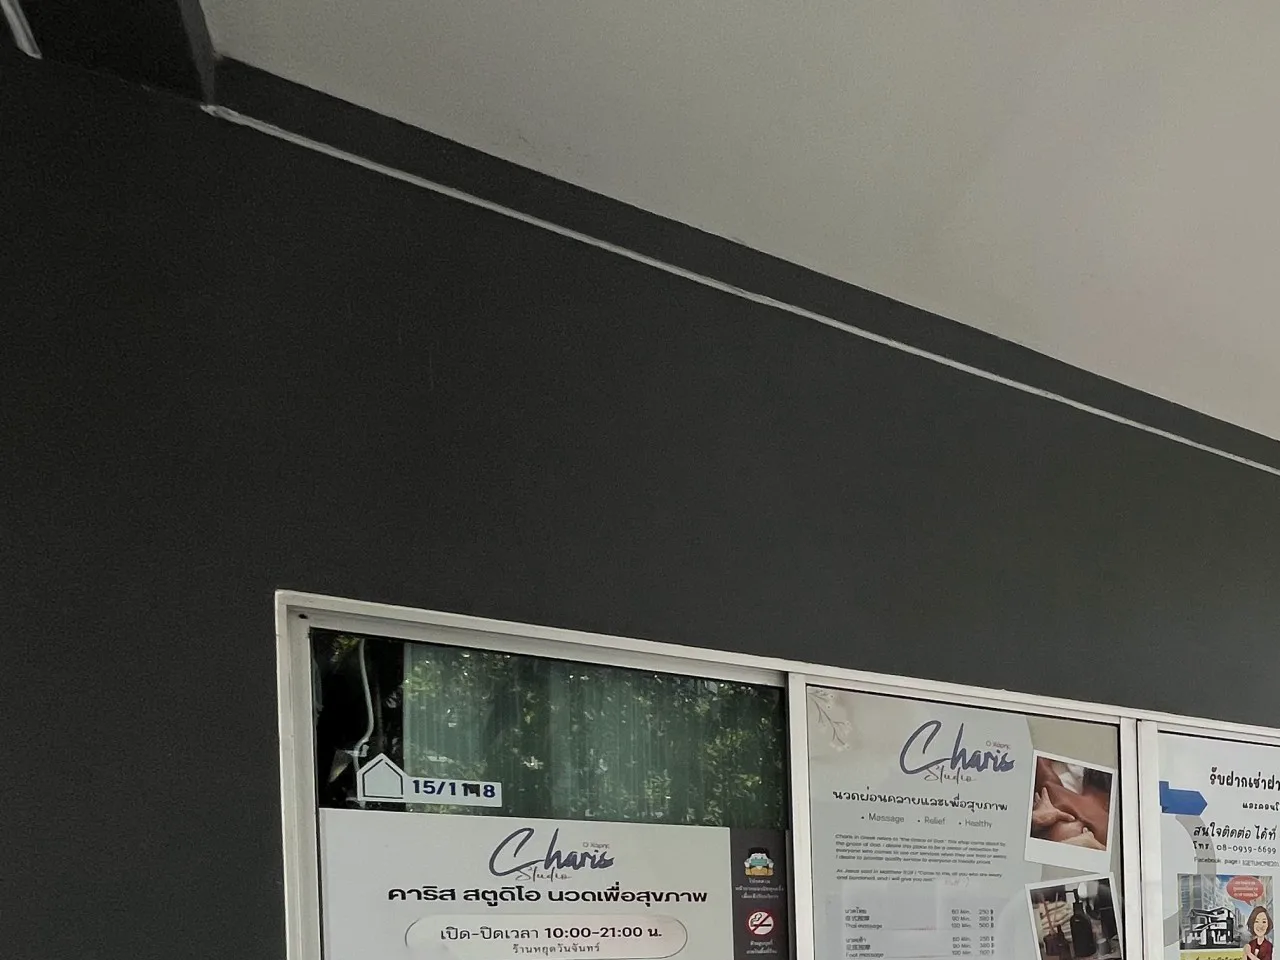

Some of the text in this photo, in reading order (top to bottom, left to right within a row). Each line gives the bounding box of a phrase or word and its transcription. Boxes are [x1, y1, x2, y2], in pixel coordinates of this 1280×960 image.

[900, 720, 1015, 774] Charis
[868, 812, 993, 829] Massage Relief Healthy
[1193, 821, 1252, 840] สนใจติดต่อ
[489, 827, 615, 877] Charis
[388, 882, 708, 908] คาริส สตูดิโอ นวดเพื่อสุขภาพ
[440, 925, 663, 941] เปิด-ปิดเวลา 10:00-21:00 น.
[512, 941, 600, 955] ร้านหยุดวันจันทร์
